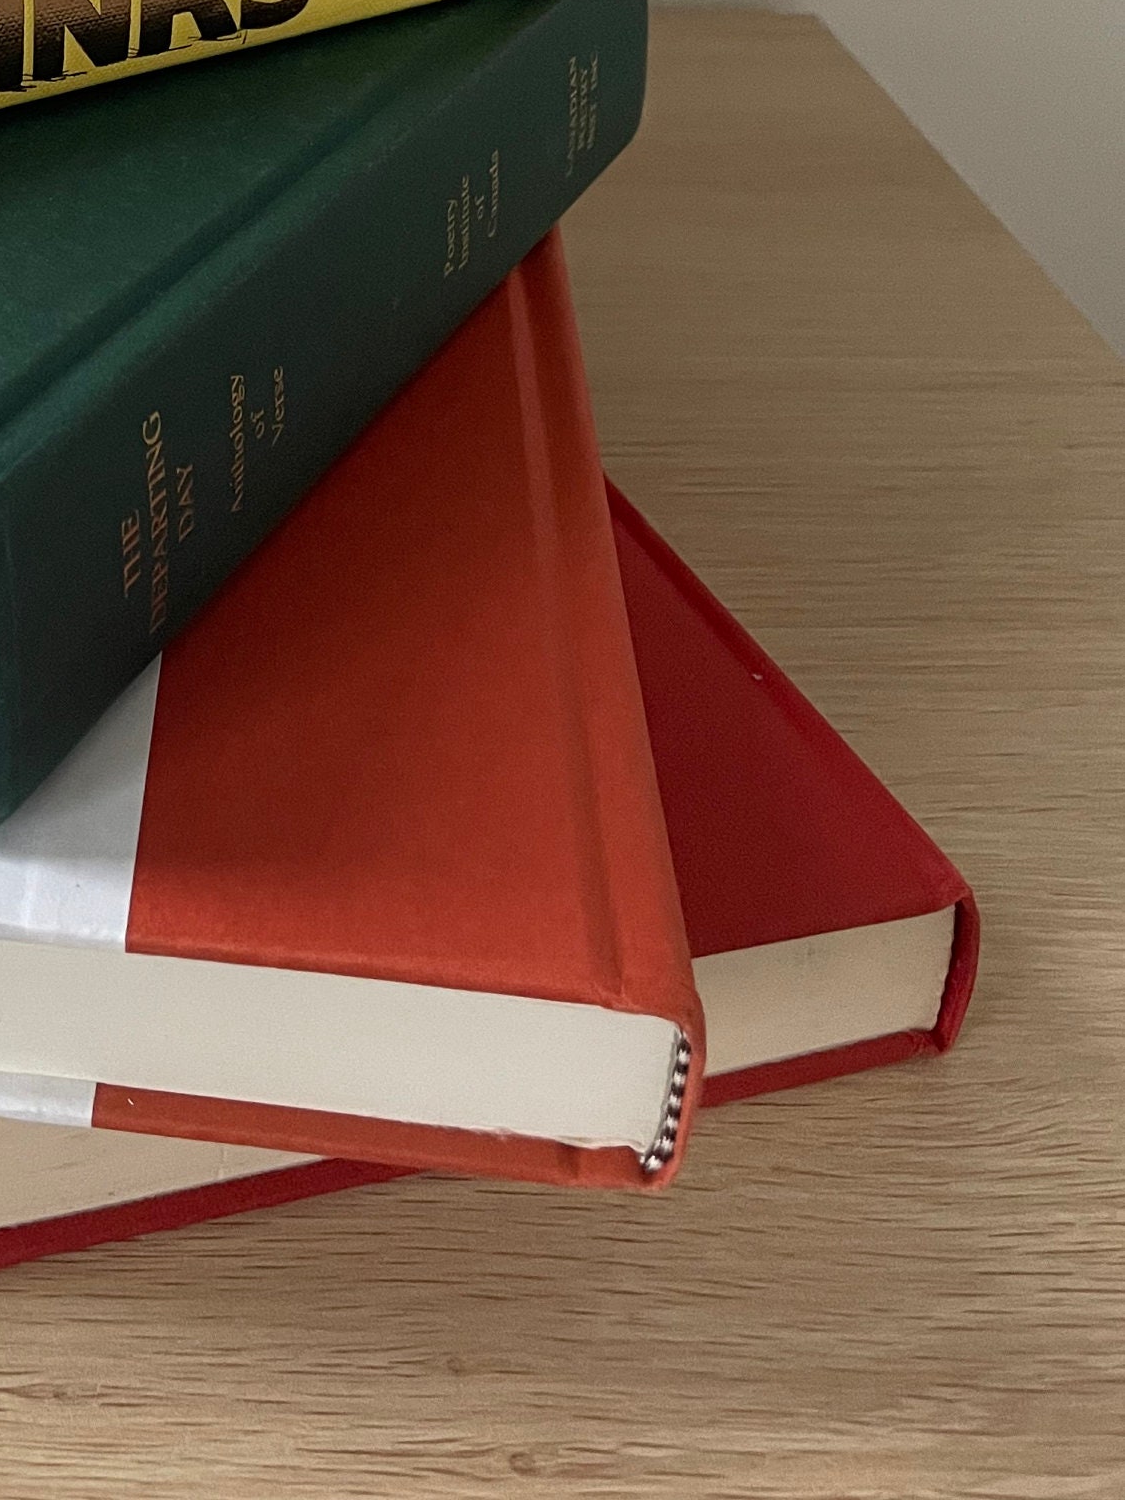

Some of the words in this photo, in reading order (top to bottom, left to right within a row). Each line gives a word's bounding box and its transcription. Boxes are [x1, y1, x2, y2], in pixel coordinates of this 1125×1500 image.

[444, 199, 458, 277] Poetry
[230, 374, 246, 513] Anthology
[250, 408, 266, 440] of
[272, 365, 285, 447] Verse
[142, 411, 168, 635] DEPARTING
[177, 464, 195, 543] DAY
[122, 509, 141, 597] THE
